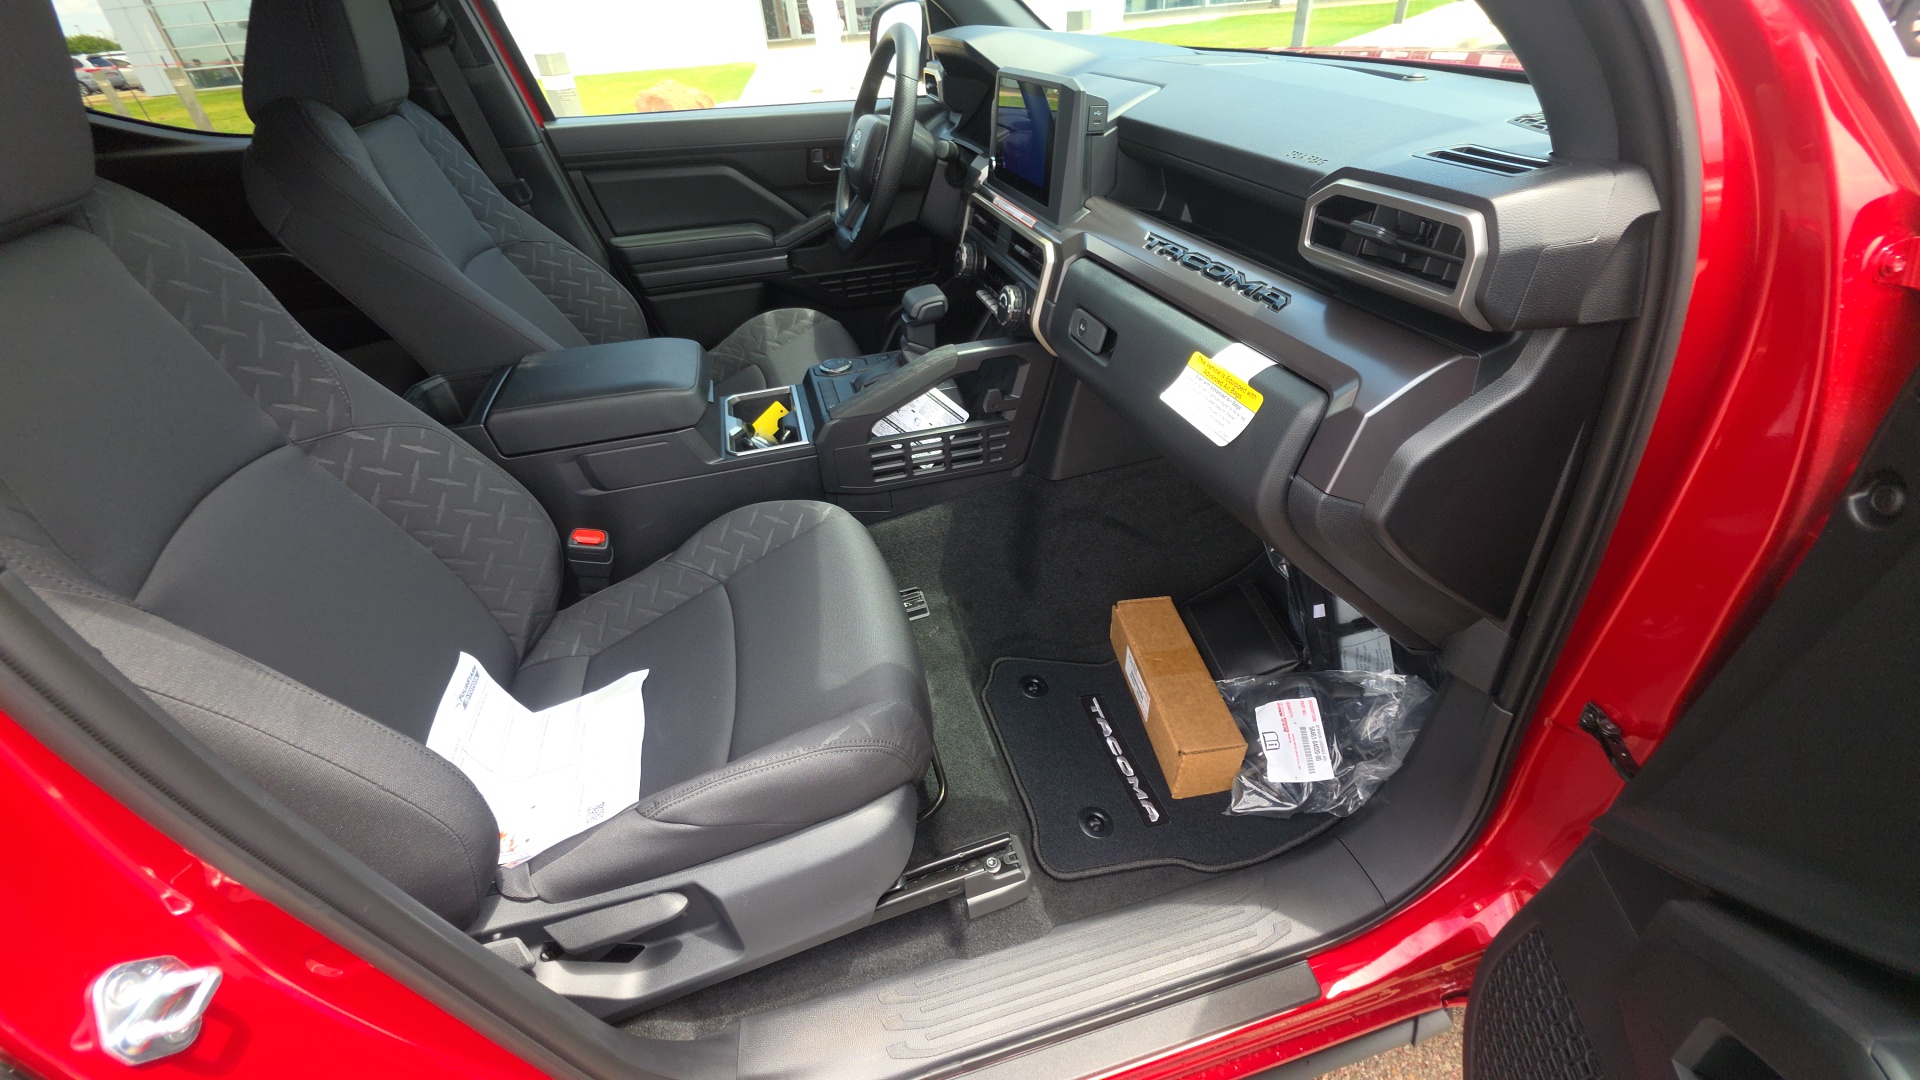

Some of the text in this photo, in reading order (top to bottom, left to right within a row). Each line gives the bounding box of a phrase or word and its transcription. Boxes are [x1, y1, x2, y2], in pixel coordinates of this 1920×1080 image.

[1142, 231, 1292, 313] TACOMA
[1198, 356, 1206, 366] This
[1226, 376, 1247, 394] Equipped
[1247, 390, 1258, 400] with
[1203, 369, 1223, 386] Advanced
[1230, 388, 1242, 400] Bags
[1090, 697, 1159, 822] TACOMA
